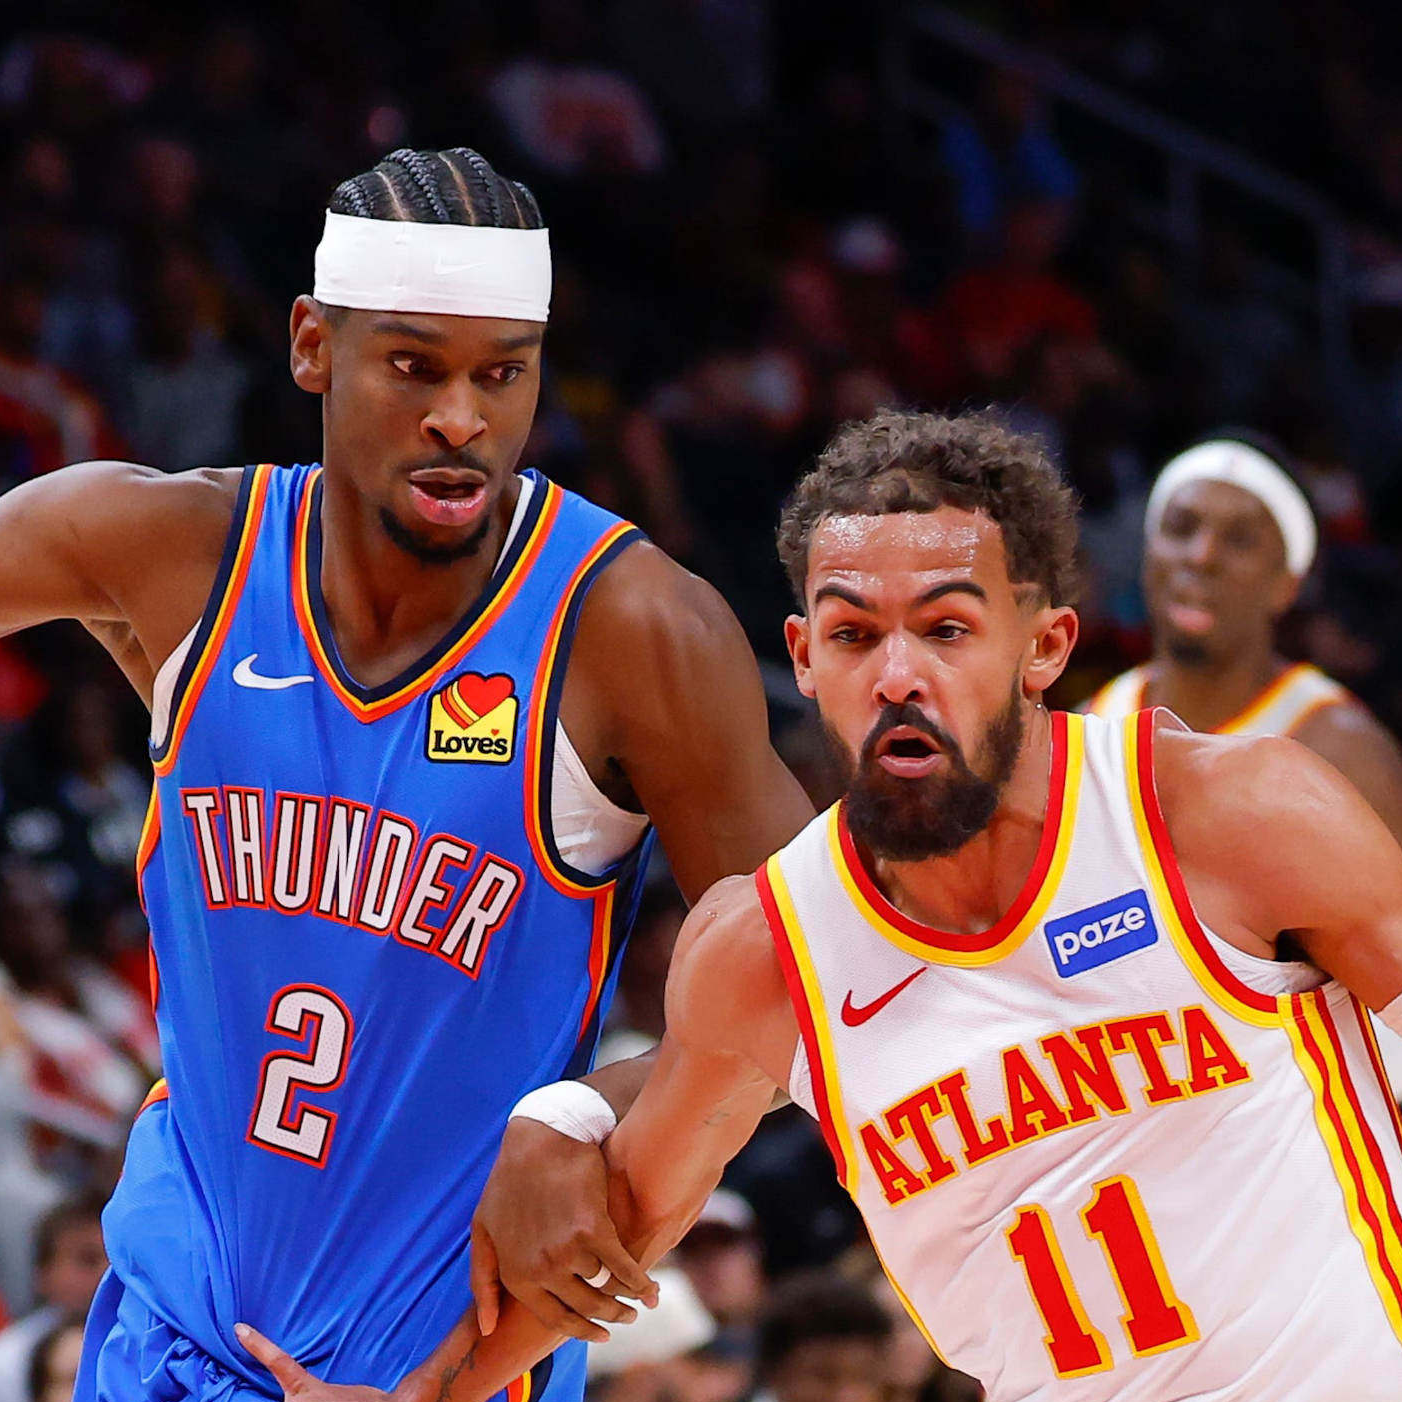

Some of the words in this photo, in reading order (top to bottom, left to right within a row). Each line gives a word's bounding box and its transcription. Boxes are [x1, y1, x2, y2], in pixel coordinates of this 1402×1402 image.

[181, 786, 526, 980] THUNDER
[1053, 906, 1146, 966] paze
[247, 983, 353, 1168] 2
[859, 1005, 1252, 1206] ATLANTA
[1005, 1174, 1199, 1378] 11
